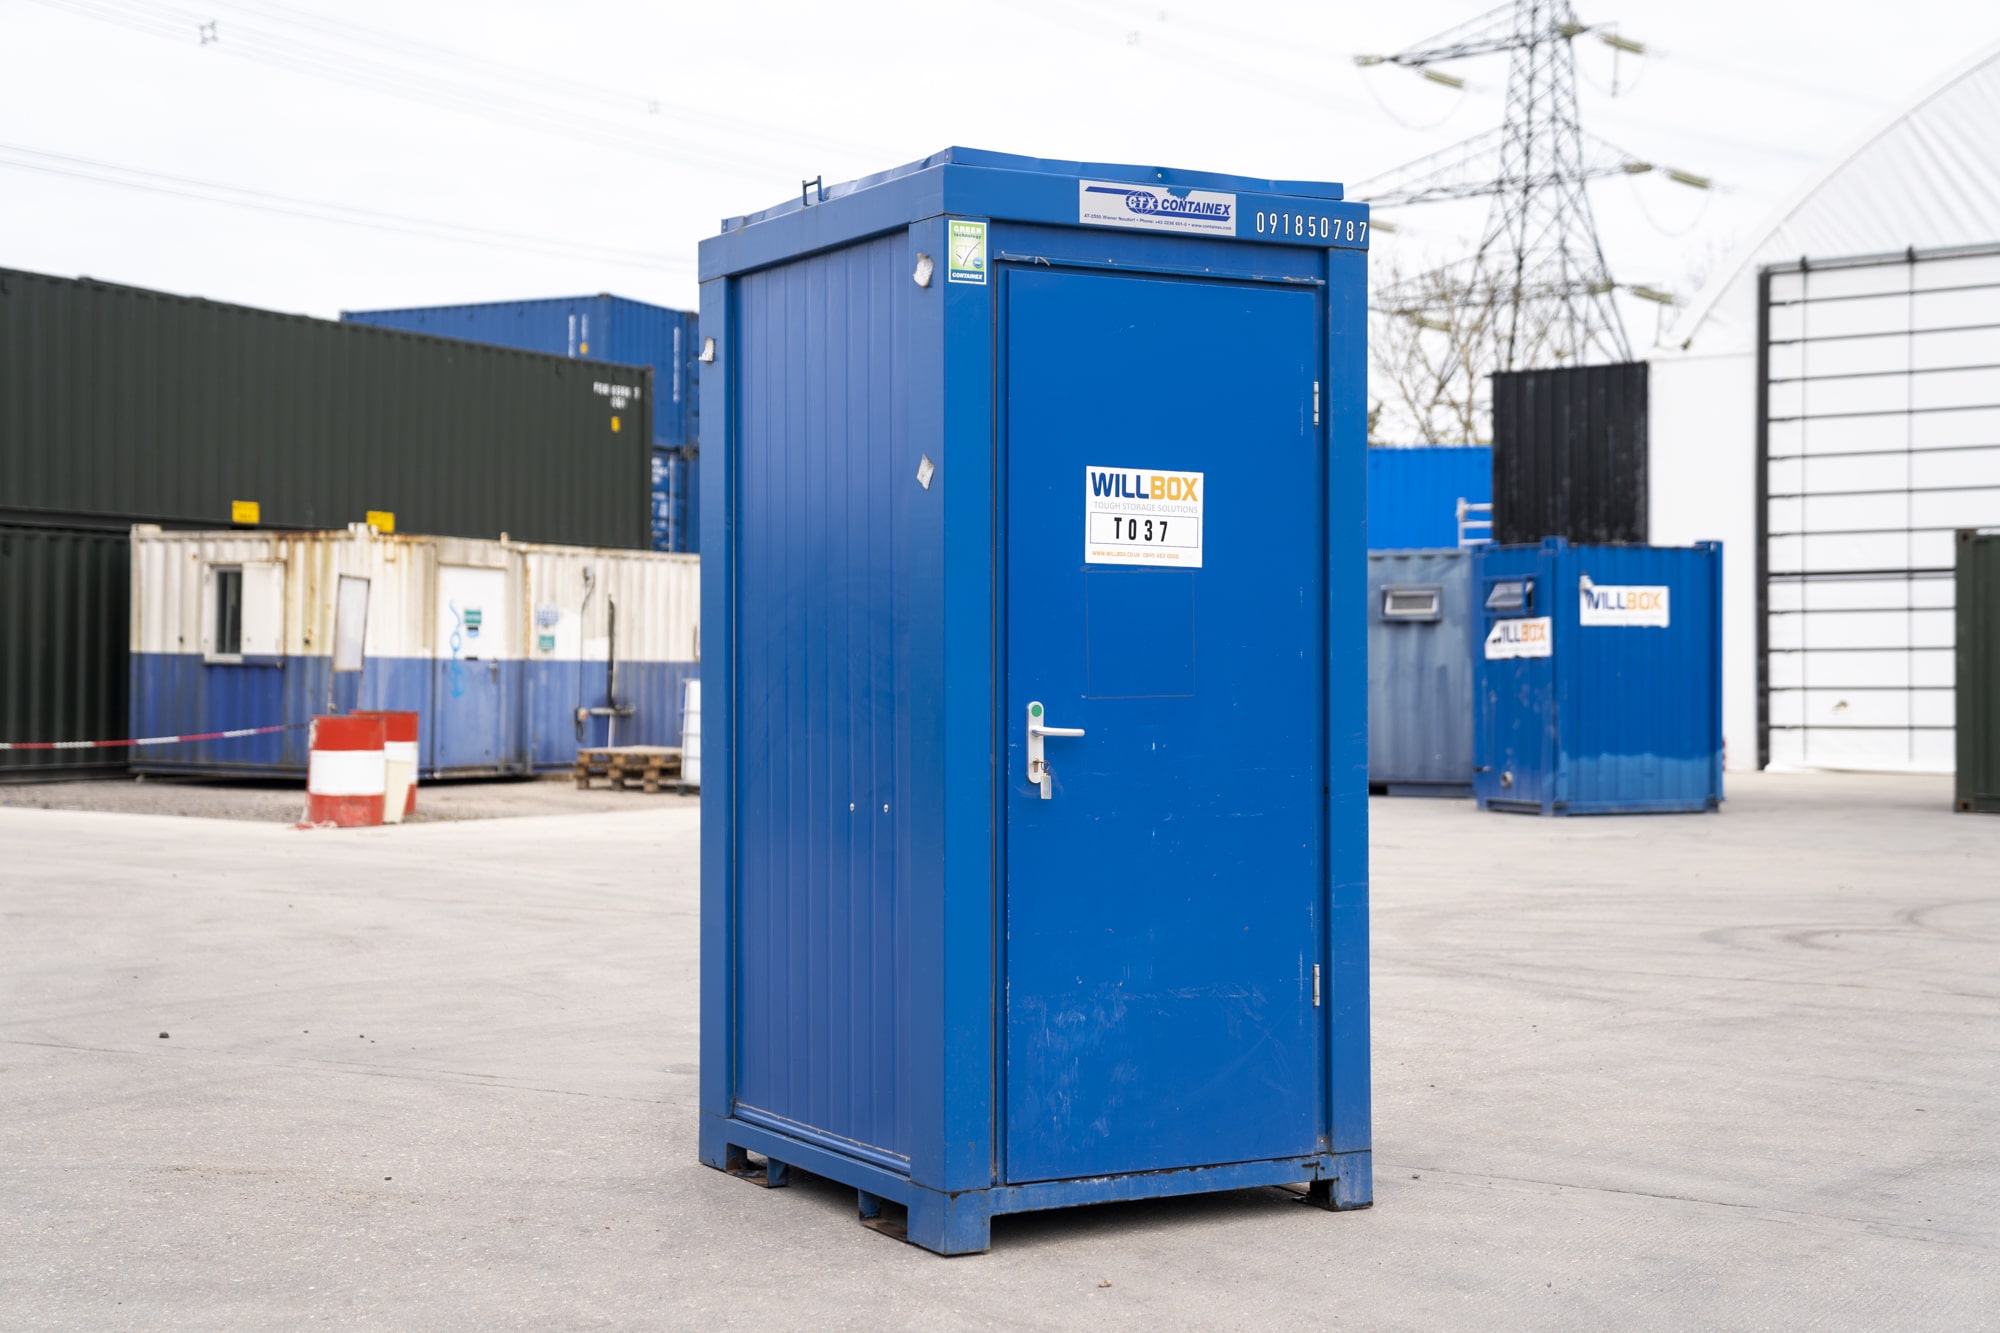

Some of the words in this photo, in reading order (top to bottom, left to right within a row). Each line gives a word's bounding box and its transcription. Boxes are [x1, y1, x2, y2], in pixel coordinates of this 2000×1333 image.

[1161, 198, 1231, 216] CONTAINEX
[953, 225, 982, 234] GREEN
[1256, 211, 1368, 242] 091850787
[1091, 472, 1198, 502] WILLBOX
[1094, 501, 1120, 510] TOUGH
[1122, 502, 1156, 512] STORAGE
[1158, 504, 1198, 514] SOLUTIONS
[1114, 517, 1168, 542] T037
